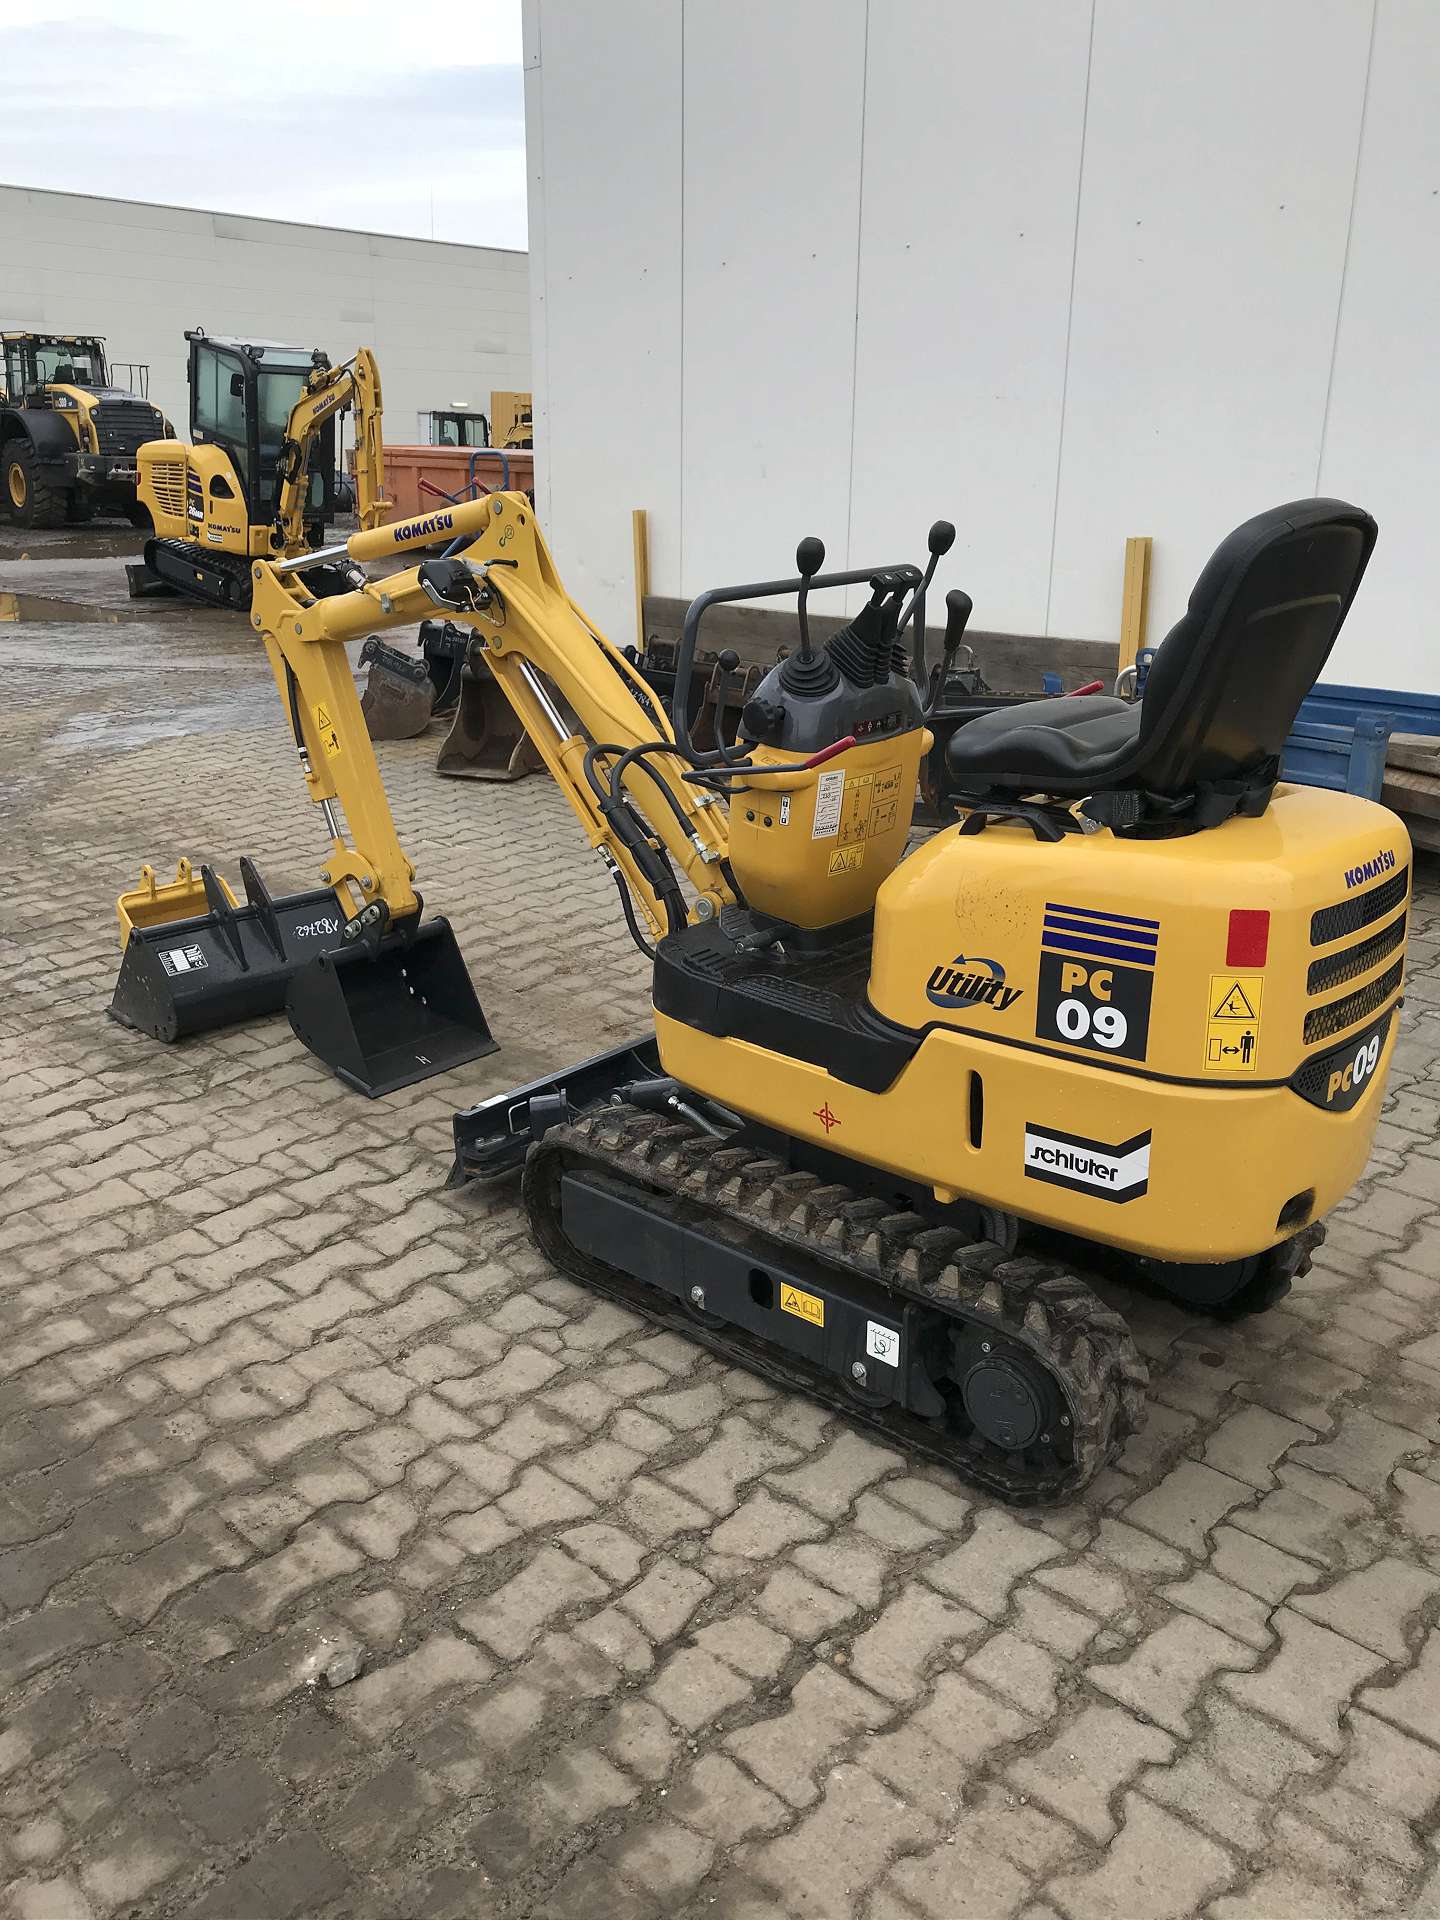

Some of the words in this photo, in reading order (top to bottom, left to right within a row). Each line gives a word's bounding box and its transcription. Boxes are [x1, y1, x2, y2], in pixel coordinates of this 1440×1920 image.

[208, 522, 241, 533] KOMATSU
[394, 514, 453, 541] KOMATSU
[1344, 850, 1395, 888] KOMATSU
[926, 966, 1024, 1011] Utility
[1061, 962, 1114, 1001] PC
[1056, 999, 1128, 1049] 09
[1030, 1146, 1119, 1181] schlüter
